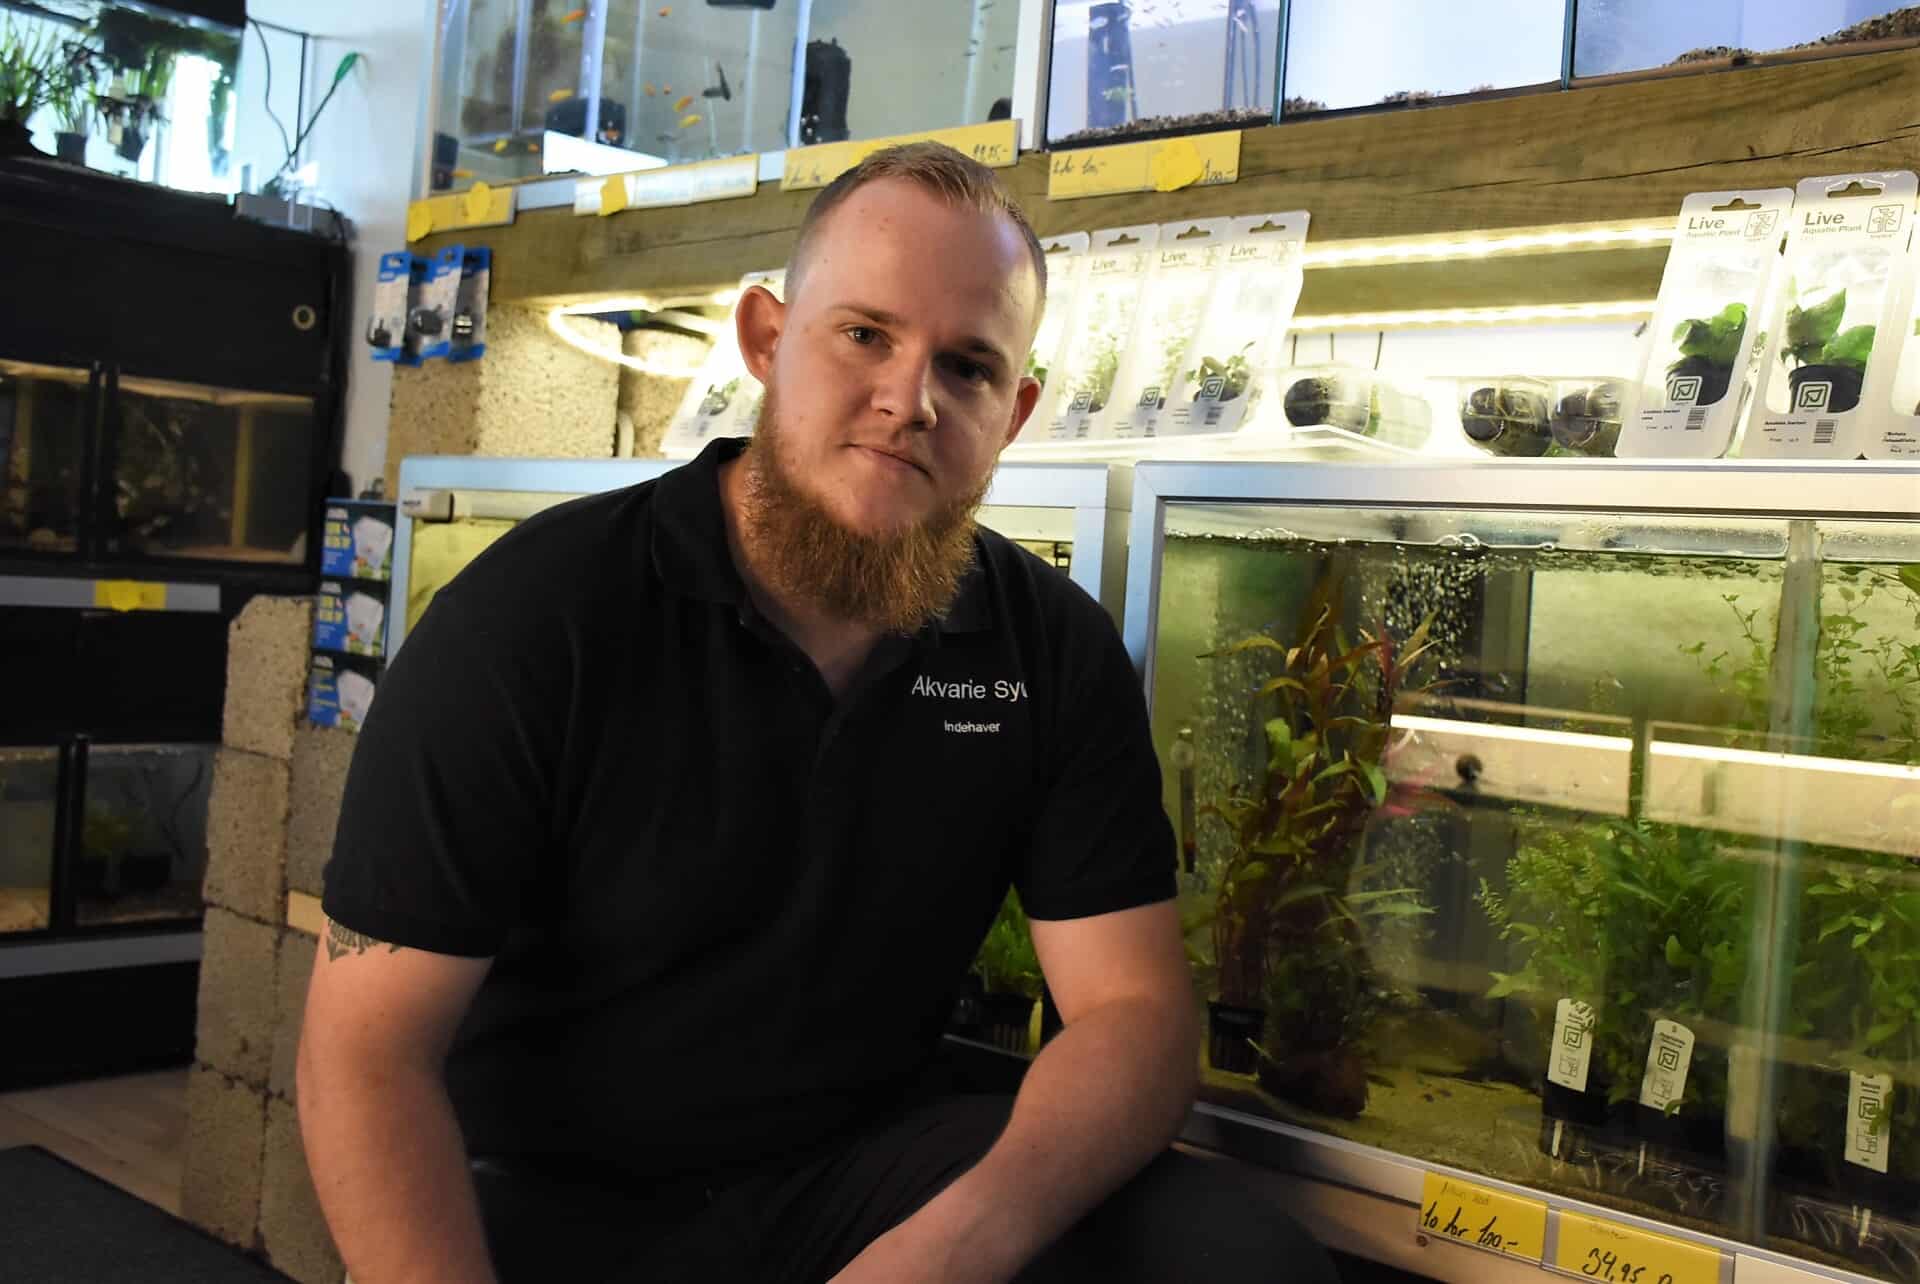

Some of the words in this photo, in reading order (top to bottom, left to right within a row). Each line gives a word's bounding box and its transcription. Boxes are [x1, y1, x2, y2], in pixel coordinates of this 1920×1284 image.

[1688, 216, 1725, 230] Live
[1804, 211, 1845, 226] Live
[1161, 251, 1186, 263] Live
[1230, 244, 1257, 257] Live
[911, 674, 987, 700] Akvarie
[944, 719, 1001, 733] Indehaver
[1423, 1200, 1439, 1229] 10
